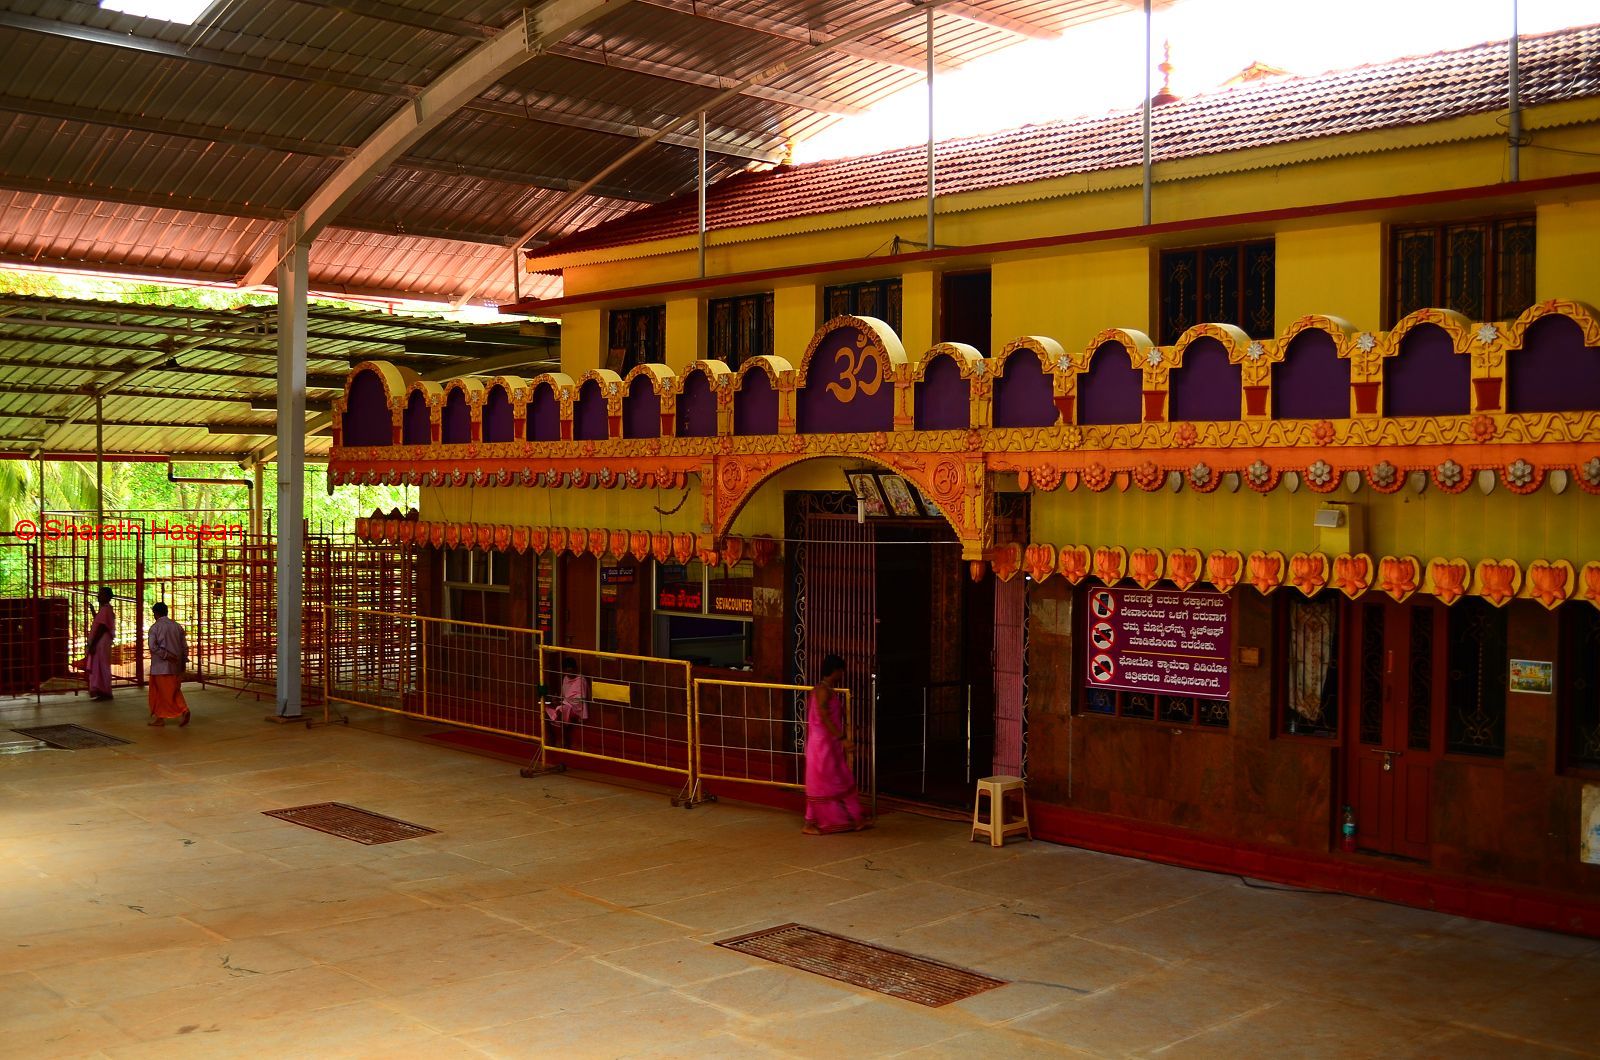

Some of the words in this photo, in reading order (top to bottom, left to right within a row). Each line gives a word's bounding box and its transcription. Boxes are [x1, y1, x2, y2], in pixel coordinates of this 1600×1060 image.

[1123, 593, 1153, 608] ದರ್ಶನಕ್ಕೆ
[1156, 596, 1180, 605] ಬರುವ
[1120, 606, 1165, 619] ದೇವಾಲಯದ
[1168, 610, 1189, 620] ಒಳಗೆ
[1192, 612, 1227, 622] ಬರುವಾಗ
[1122, 622, 1140, 635] ತಮ್ಮ
[1129, 636, 1177, 648] ಮಾಡಿಕೊಂಡು
